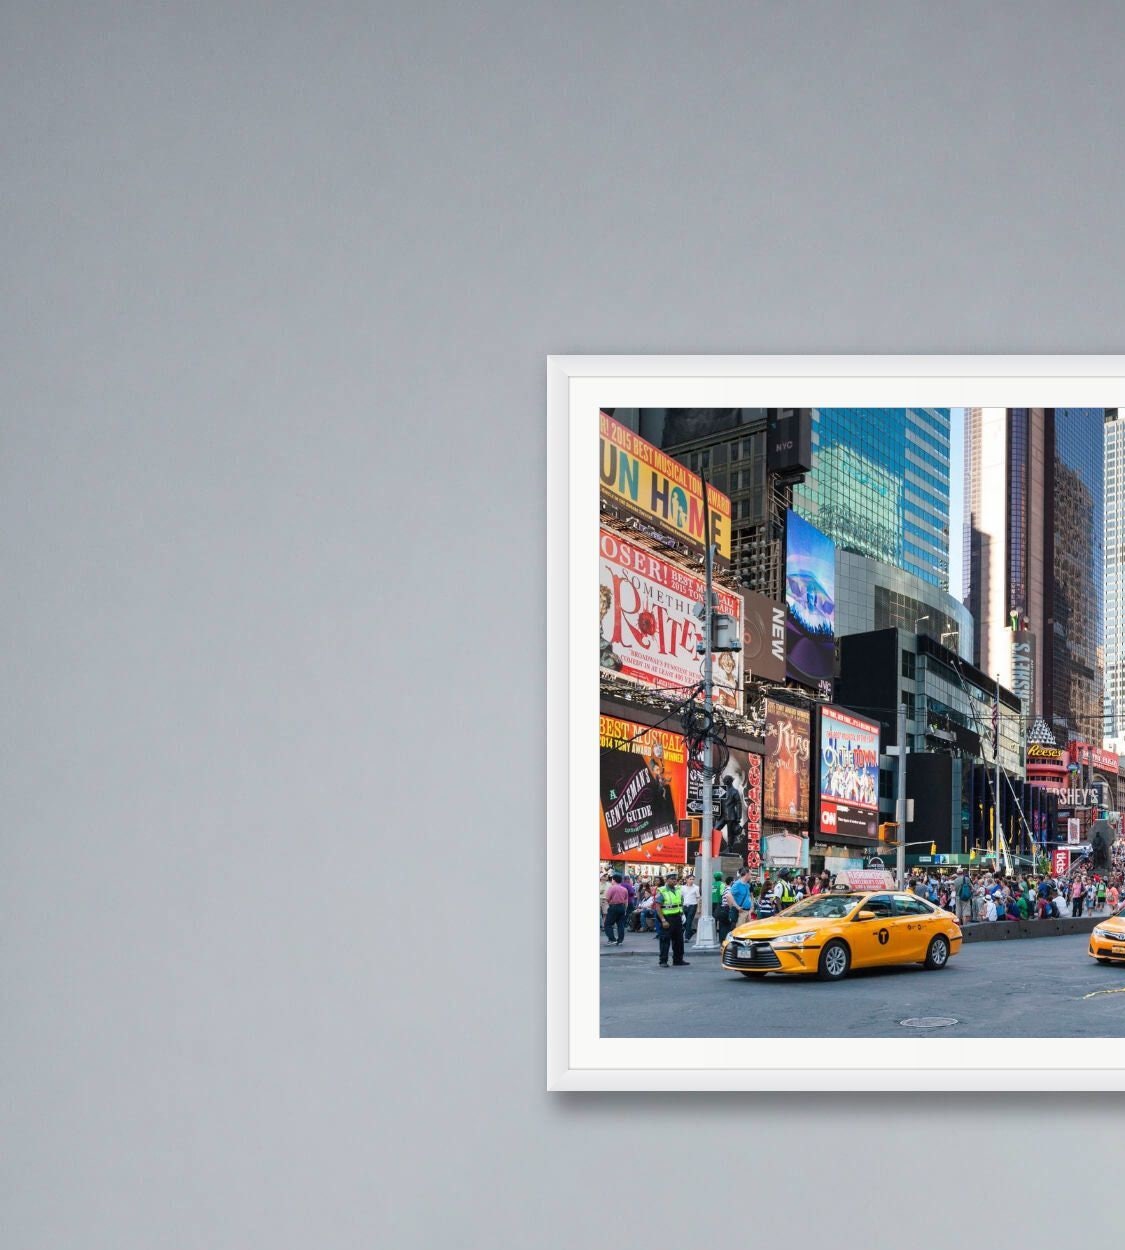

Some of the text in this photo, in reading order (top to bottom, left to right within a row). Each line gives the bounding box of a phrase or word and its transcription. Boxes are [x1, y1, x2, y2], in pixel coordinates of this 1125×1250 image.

[775, 440, 793, 453] NYC
[611, 422, 627, 451] 2015
[628, 436, 650, 464] BEST
[650, 451, 688, 488] MUSICAL
[688, 474, 703, 500] TON
[708, 486, 731, 518] AWARD
[600, 438, 639, 501] UN
[650, 471, 723, 552] HOME
[671, 571, 694, 590] BEST
[671, 580, 687, 595] 2015
[622, 568, 691, 615] SOMETHI
[771, 607, 785, 661] NEW
[818, 679, 832, 693] JVC
[600, 716, 629, 741] BEST
[771, 720, 810, 761] King
[1027, 744, 1064, 757] Reese's
[605, 767, 650, 829] GENTLEMAN'S
[609, 789, 618, 800] A
[1041, 787, 1099, 806] RSHEY'S
[626, 804, 653, 823] GUIDE
[1056, 852, 1067, 874] tkts
